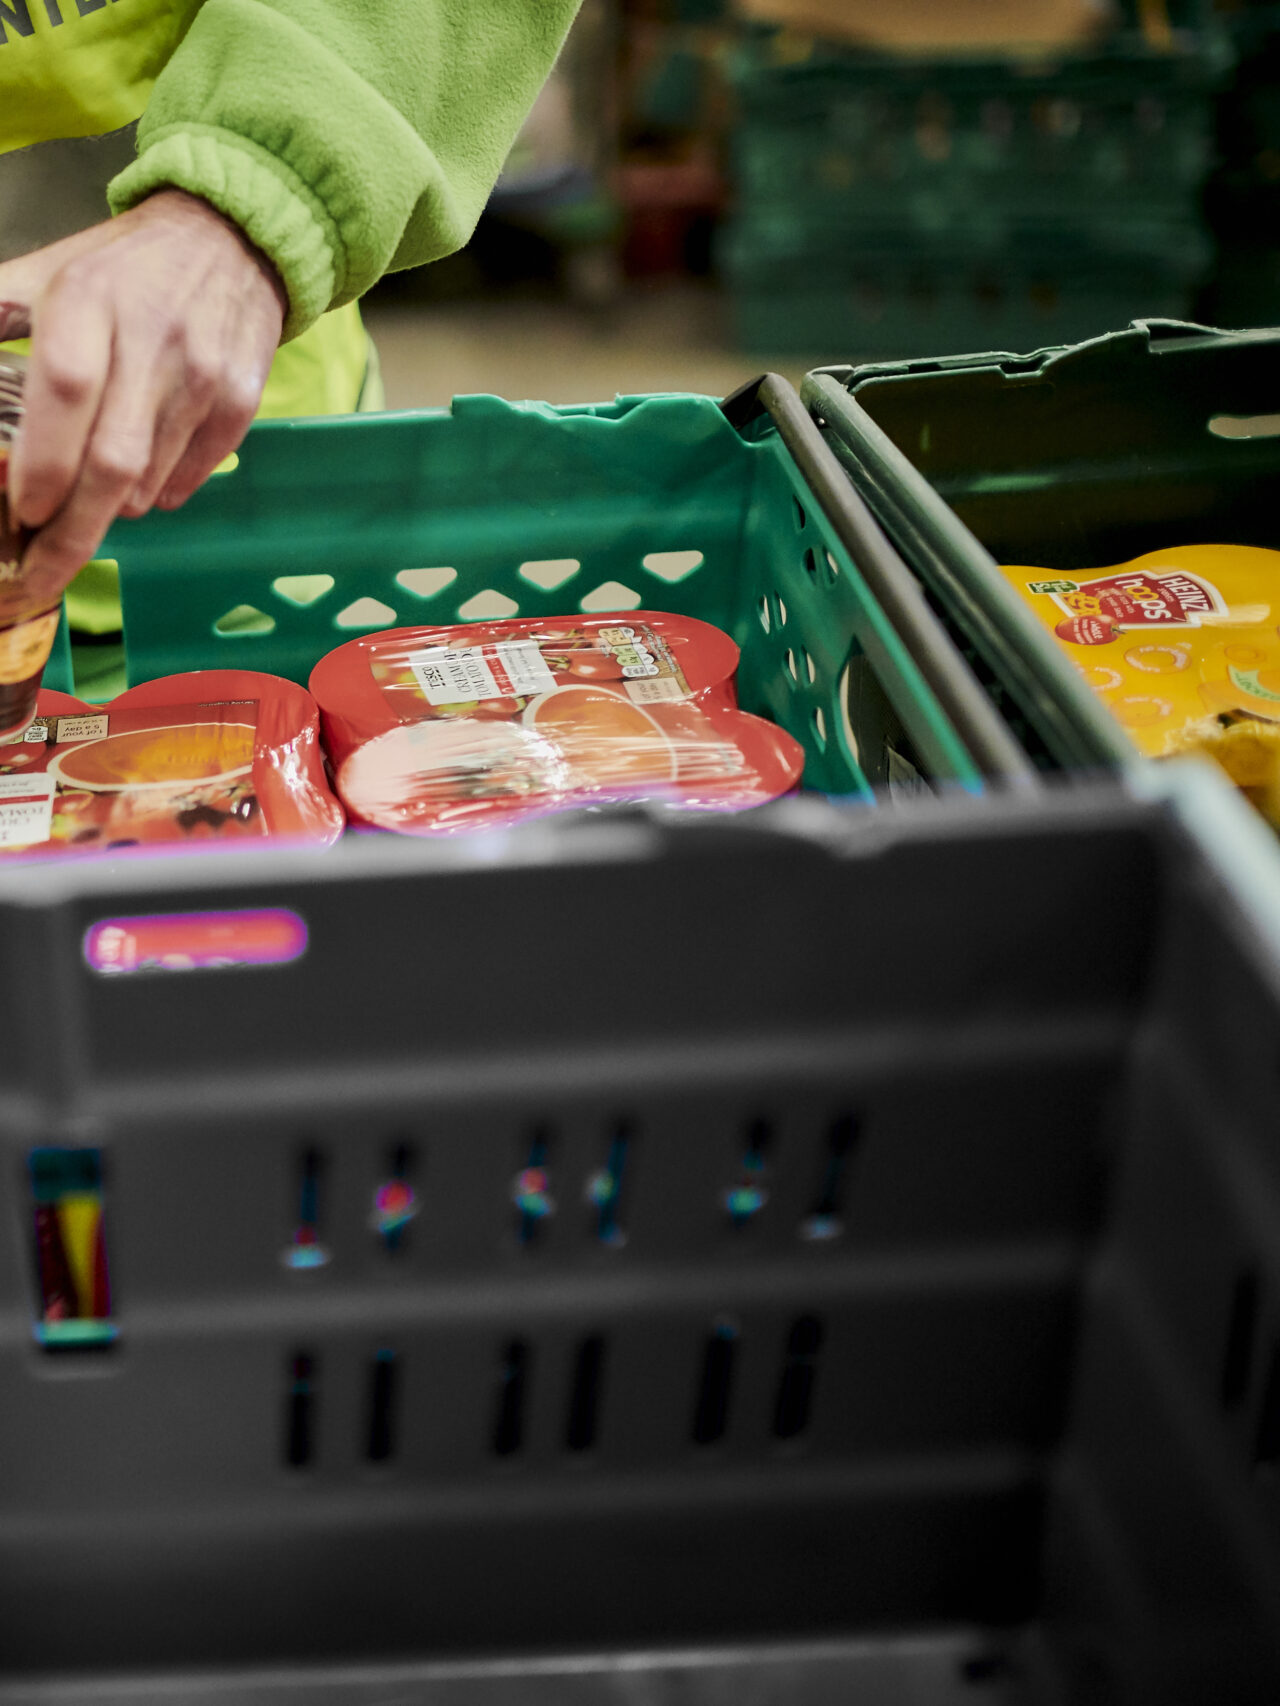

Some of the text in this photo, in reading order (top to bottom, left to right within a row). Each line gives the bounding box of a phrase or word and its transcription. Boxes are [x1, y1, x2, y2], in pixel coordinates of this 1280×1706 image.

[1115, 577, 1172, 620] hoops
[1158, 577, 1210, 611] HEINZ
[422, 666, 441, 690] TESCO
